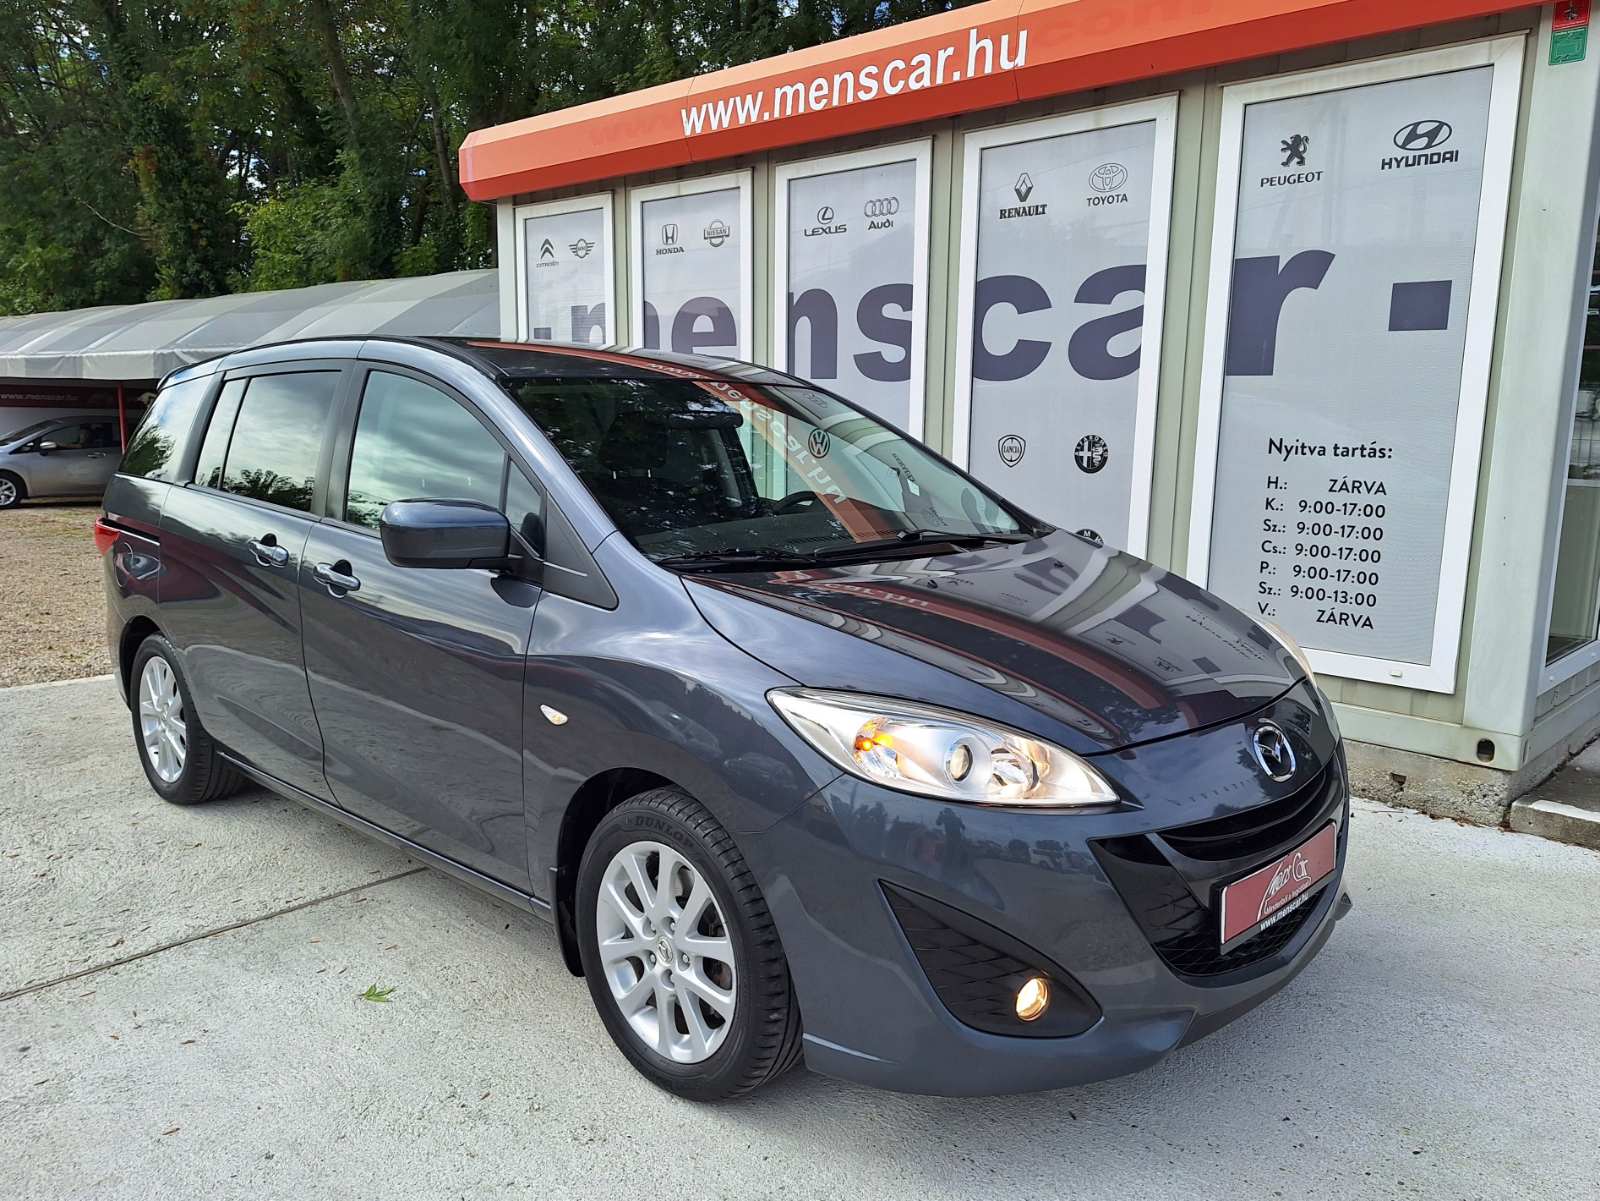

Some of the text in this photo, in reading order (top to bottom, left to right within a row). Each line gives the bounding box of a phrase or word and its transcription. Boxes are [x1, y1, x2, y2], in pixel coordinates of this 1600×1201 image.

[681, 28, 1028, 136] www.menscar.hu
[1381, 150, 1459, 170] HYUNDAI
[1260, 171, 1324, 187] PEUGEOT
[1087, 193, 1128, 207] TOYOTA
[999, 204, 1047, 219] RENAULT
[804, 224, 847, 237] LEXUS
[868, 219, 894, 230] Audi
[655, 246, 685, 255] HONDA
[1268, 437, 1393, 462] Nyitva tartás:
[1267, 475, 1387, 496] H.: ZÁRVA
[1265, 497, 1386, 518] K.: 9:00-17:00
[1263, 519, 1384, 541] Sz.: 9:00-17:00
[1261, 540, 1381, 563] Cs.: 9:00-17:00
[1260, 561, 1379, 585] P.: 9:00-17:00
[1258, 581, 1377, 607] Sz.: 9:00-13:00
[1258, 601, 1374, 629] V.: ZÁRVA
